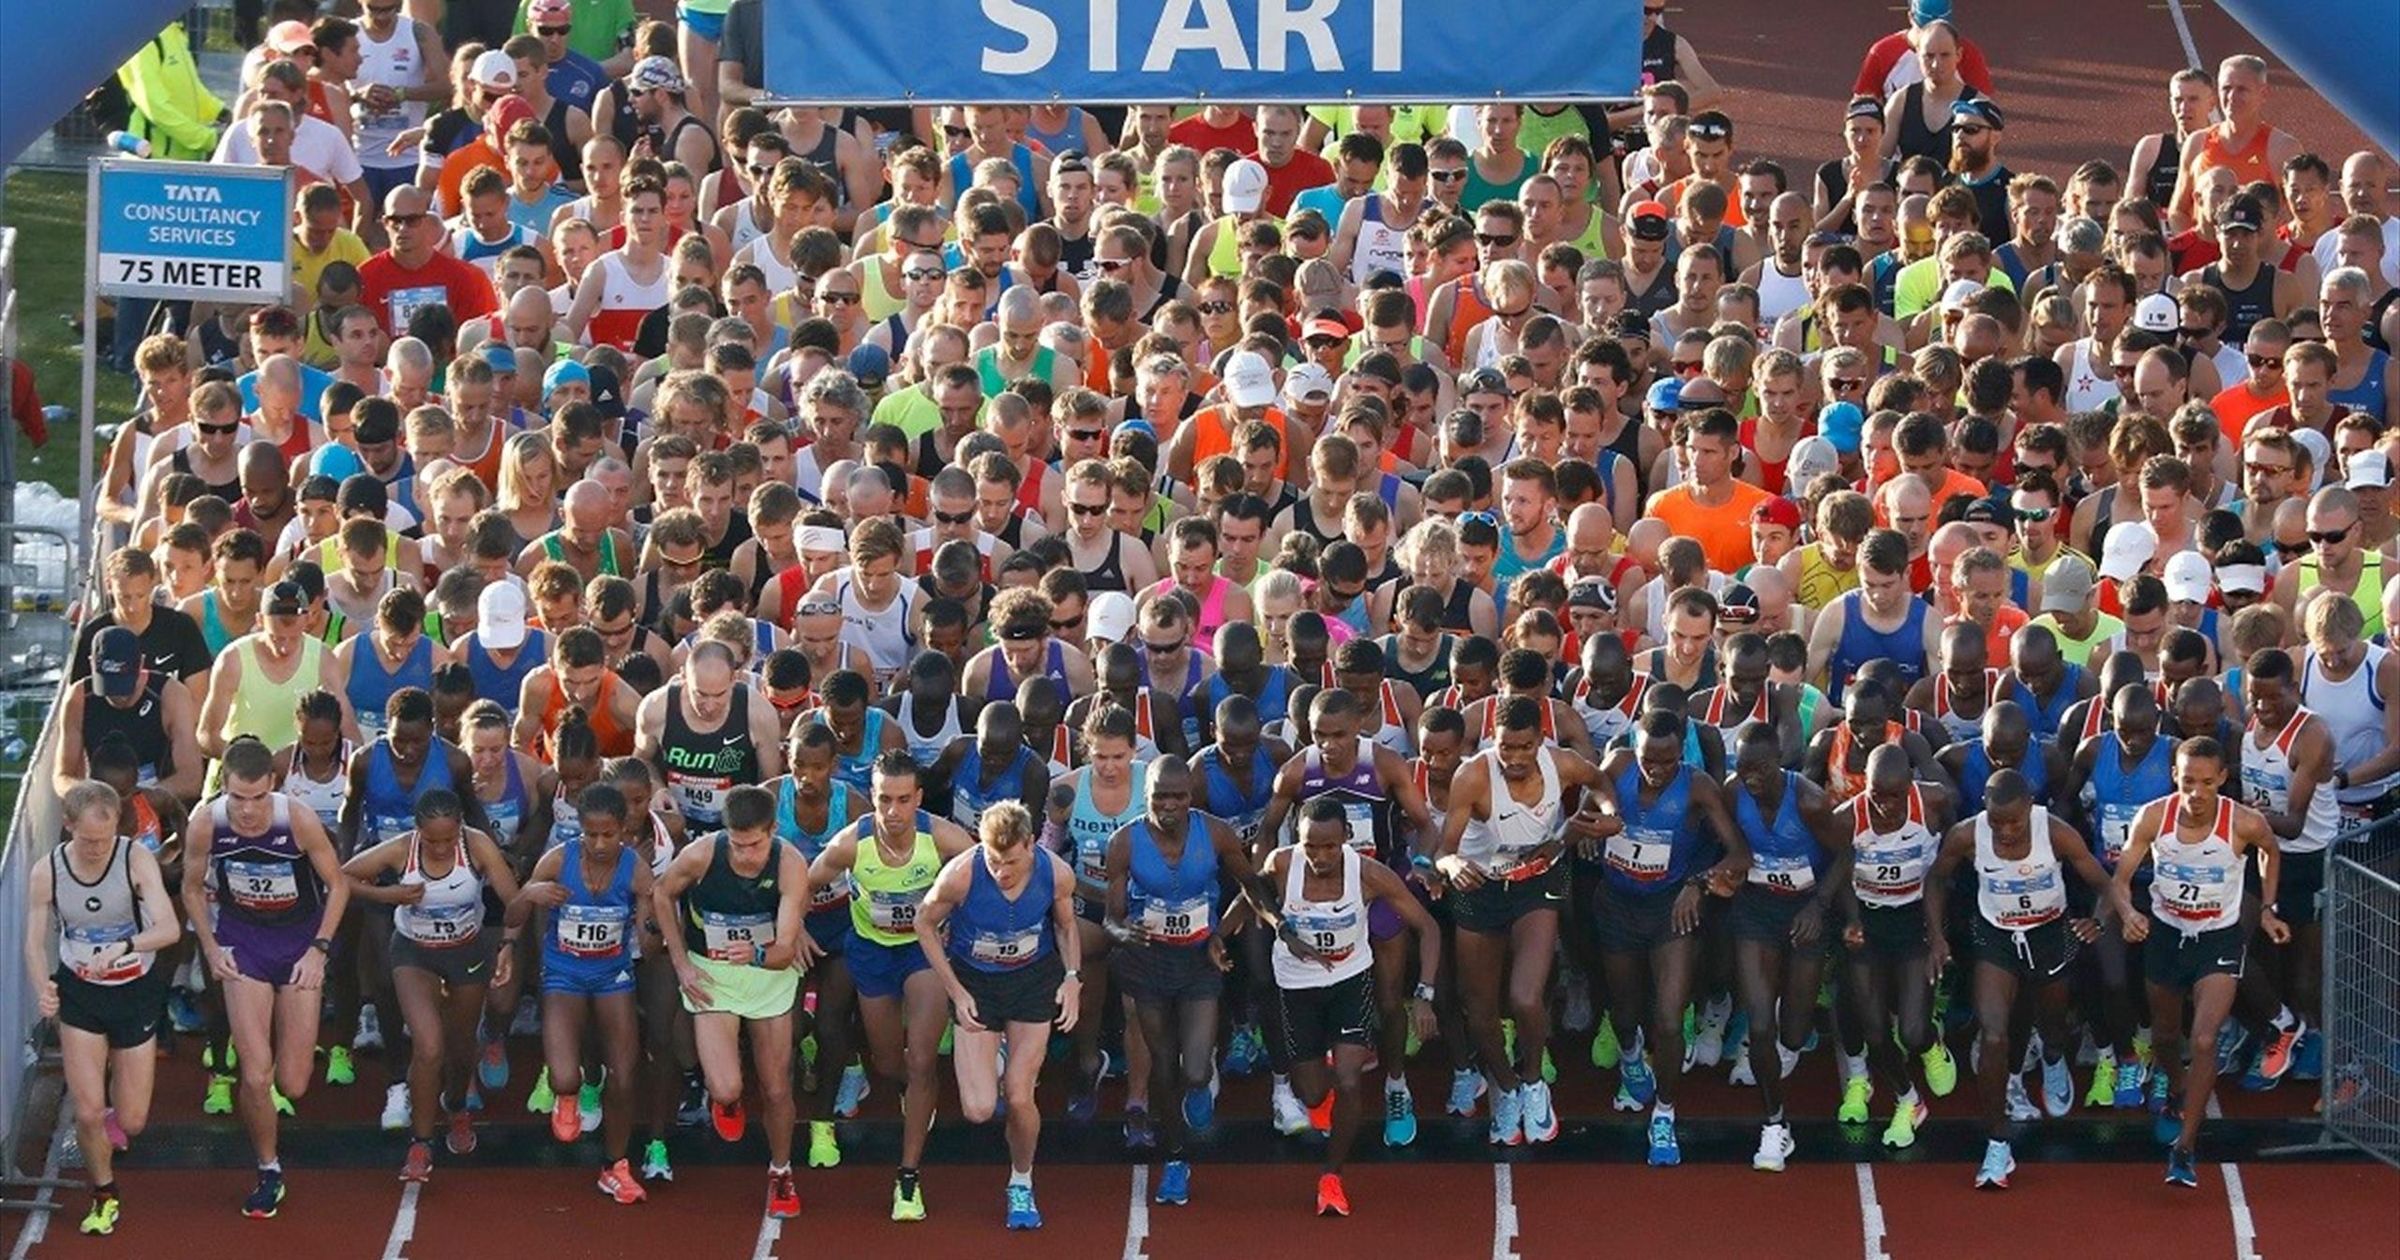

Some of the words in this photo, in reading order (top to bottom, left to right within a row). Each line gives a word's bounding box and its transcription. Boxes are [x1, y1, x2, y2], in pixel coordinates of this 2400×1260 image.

[164, 184, 222, 203] TATA
[124, 203, 262, 227] CONSULTANCY
[149, 226, 236, 246] SERVICES
[119, 260, 153, 283] 75
[162, 261, 262, 289] METER
[1632, 843, 1643, 859] 7
[1877, 865, 1901, 880] 29
[249, 878, 273, 893] 32
[2179, 883, 2200, 901] 27
[2019, 895, 2031, 909] 6
[1165, 914, 1190, 928] 80
[577, 924, 609, 942] F16
[727, 928, 752, 942] 83
[1314, 931, 1335, 947] 19
